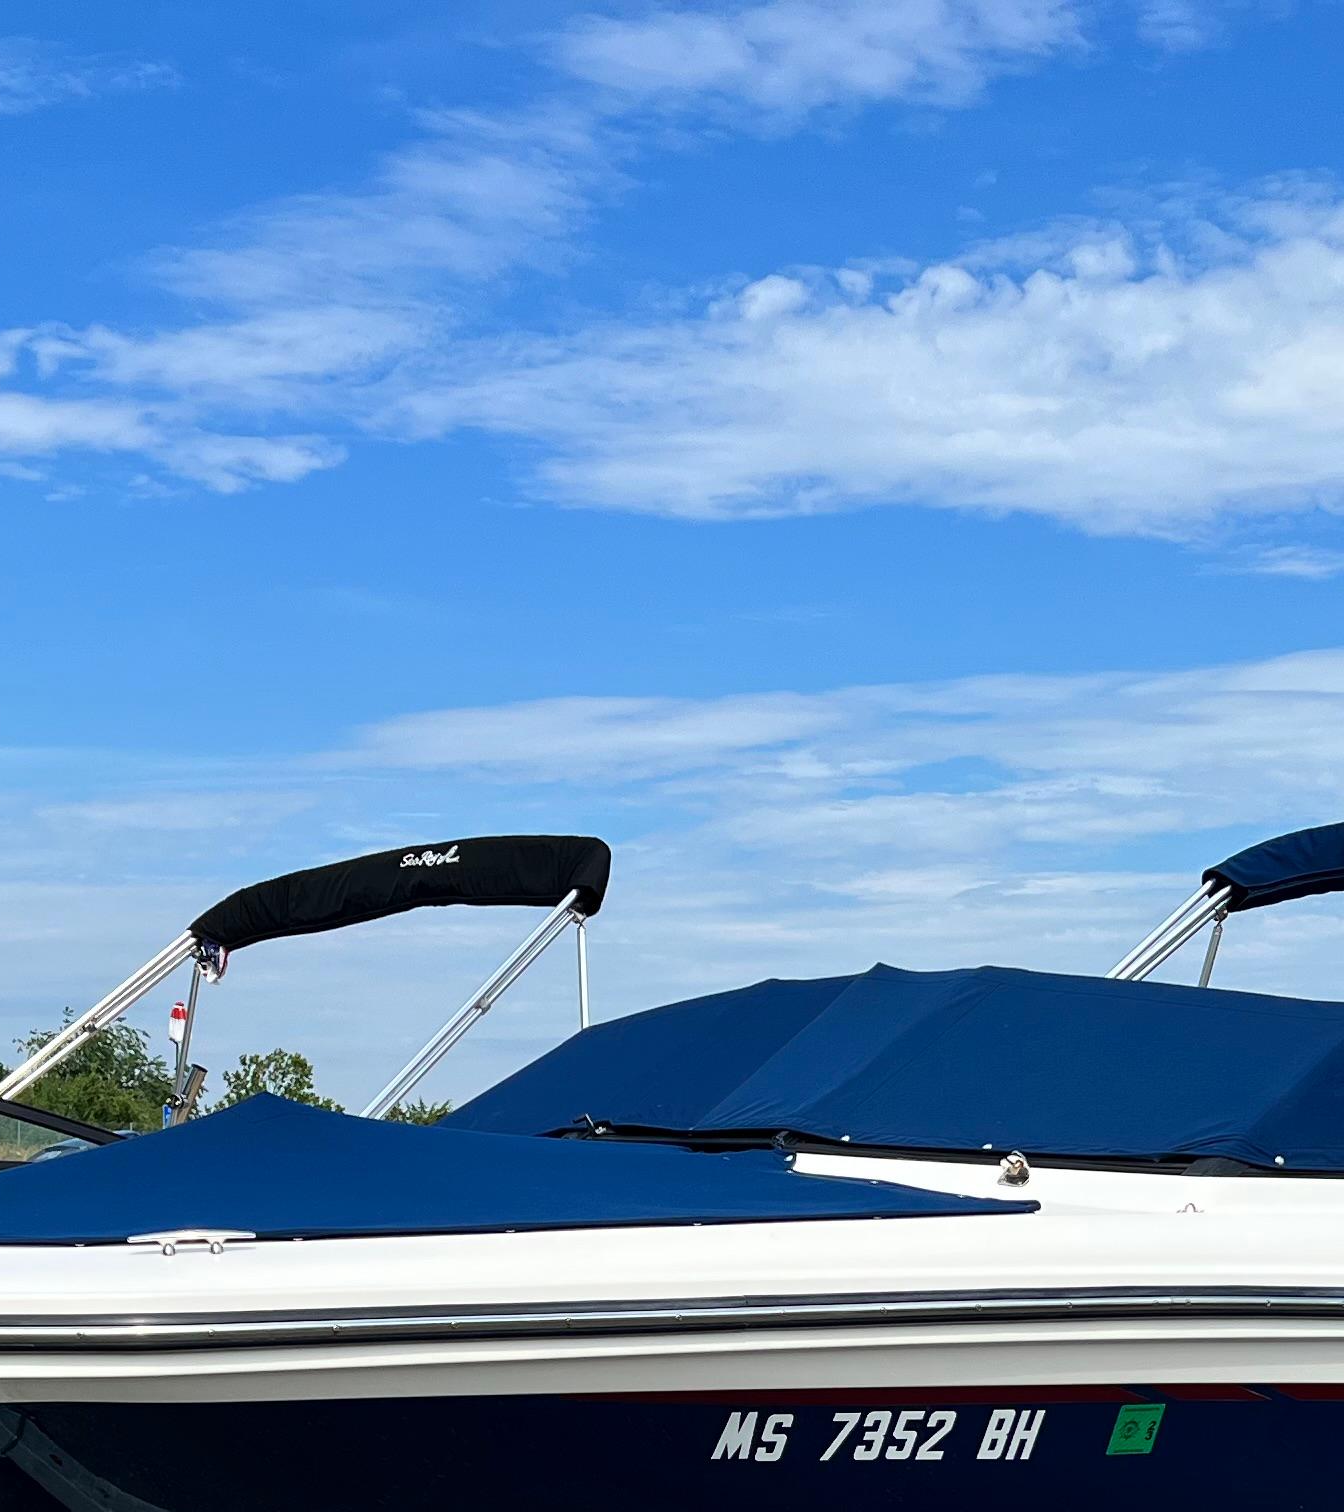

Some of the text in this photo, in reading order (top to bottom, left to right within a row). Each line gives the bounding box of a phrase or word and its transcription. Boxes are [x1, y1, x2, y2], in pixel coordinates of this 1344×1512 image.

[711, 1409, 1046, 1462] MS 7352 BH
